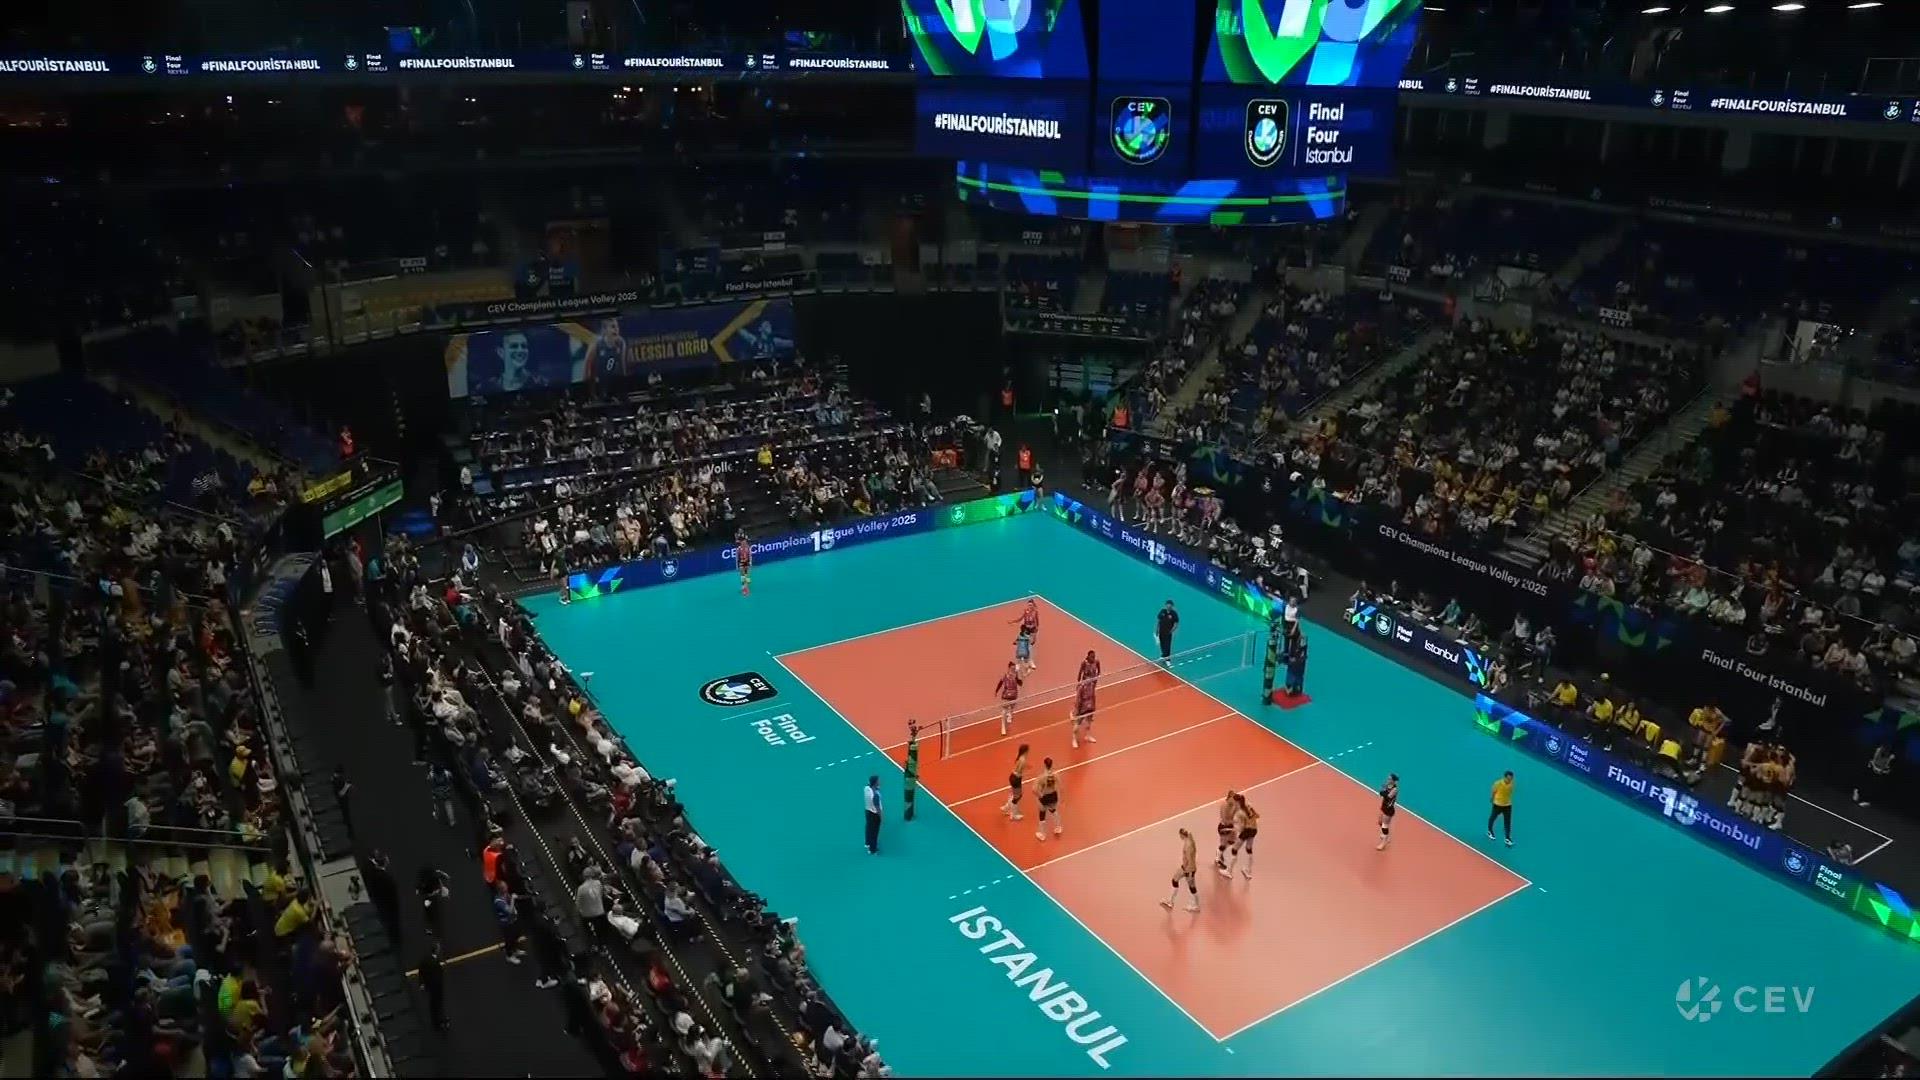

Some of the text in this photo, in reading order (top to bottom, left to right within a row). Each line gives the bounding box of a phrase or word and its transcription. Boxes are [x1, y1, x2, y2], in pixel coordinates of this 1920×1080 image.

[201, 57, 320, 73] #FINALFOURİSTANBUL
[399, 57, 515, 70] #FINALFOURİSTANBUL
[624, 55, 725, 68] #FINALFOURİSTANBUL
[789, 58, 889, 70] #FINALFOURİSTANBUL
[1398, 79, 1424, 90] NBUL
[1490, 84, 1592, 101] #FINALFOURİSTANBUL
[1127, 102, 1155, 113] CEV
[1257, 105, 1278, 115] CEV
[1308, 102, 1345, 121] Final
[1710, 98, 1848, 117] #FINALFOURİSTANBUL
[934, 112, 1062, 140] #FINALFOURİSTANBUL
[1306, 126, 1340, 144] Four
[1304, 146, 1354, 165] Istanbul
[488, 291, 638, 313] CEV Champions League Volley 2025
[857, 521, 889, 534] Volley
[891, 513, 917, 528] 2025
[810, 530, 835, 552] 15
[1121, 530, 1140, 547] Final
[1379, 524, 1548, 598] CEV Champions League Volley 2025
[1396, 633, 1411, 643] Four
[1397, 625, 1413, 638] Final
[1424, 640, 1459, 664] Istanbul
[749, 677, 769, 692] CEV
[1702, 649, 1827, 707] Final Four Istanbul
[749, 719, 787, 746] Four
[771, 713, 817, 744] Final
[1569, 751, 1585, 762] Four
[1571, 744, 1589, 756] Final
[1607, 765, 1647, 794] Final
[1662, 787, 1699, 826] 15
[1817, 872, 1838, 887] Four
[1819, 864, 1842, 880] Final
[948, 905, 1129, 1070] ISTANBUL
